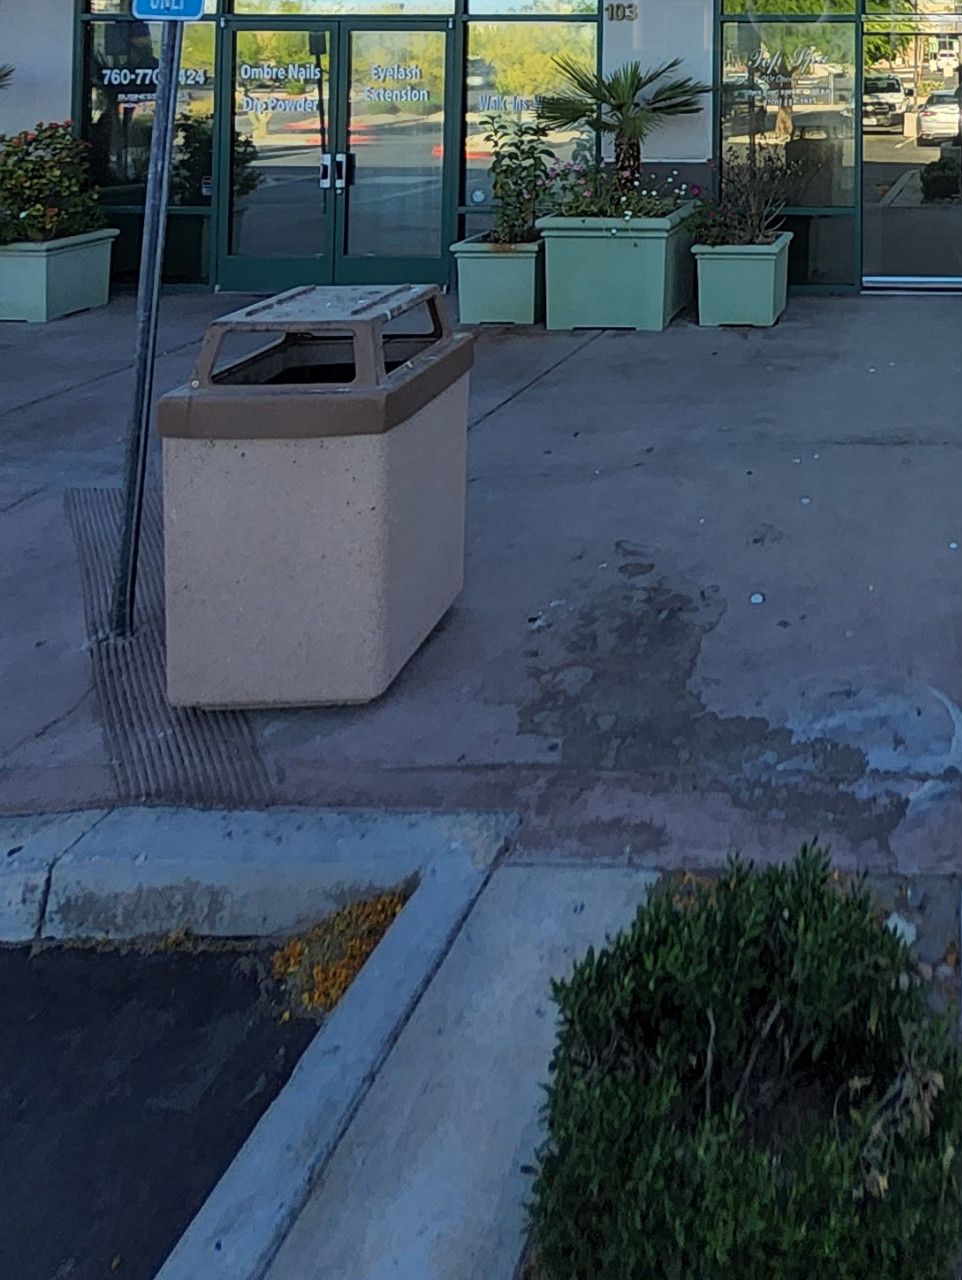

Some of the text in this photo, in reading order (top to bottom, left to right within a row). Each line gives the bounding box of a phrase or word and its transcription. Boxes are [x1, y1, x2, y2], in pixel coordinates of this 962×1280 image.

[605, 3, 639, 21] 103
[240, 64, 321, 80] Ombre Nails
[371, 63, 422, 82] Eyelash
[364, 85, 430, 102] Extension
[242, 97, 319, 113] Dip Powder
